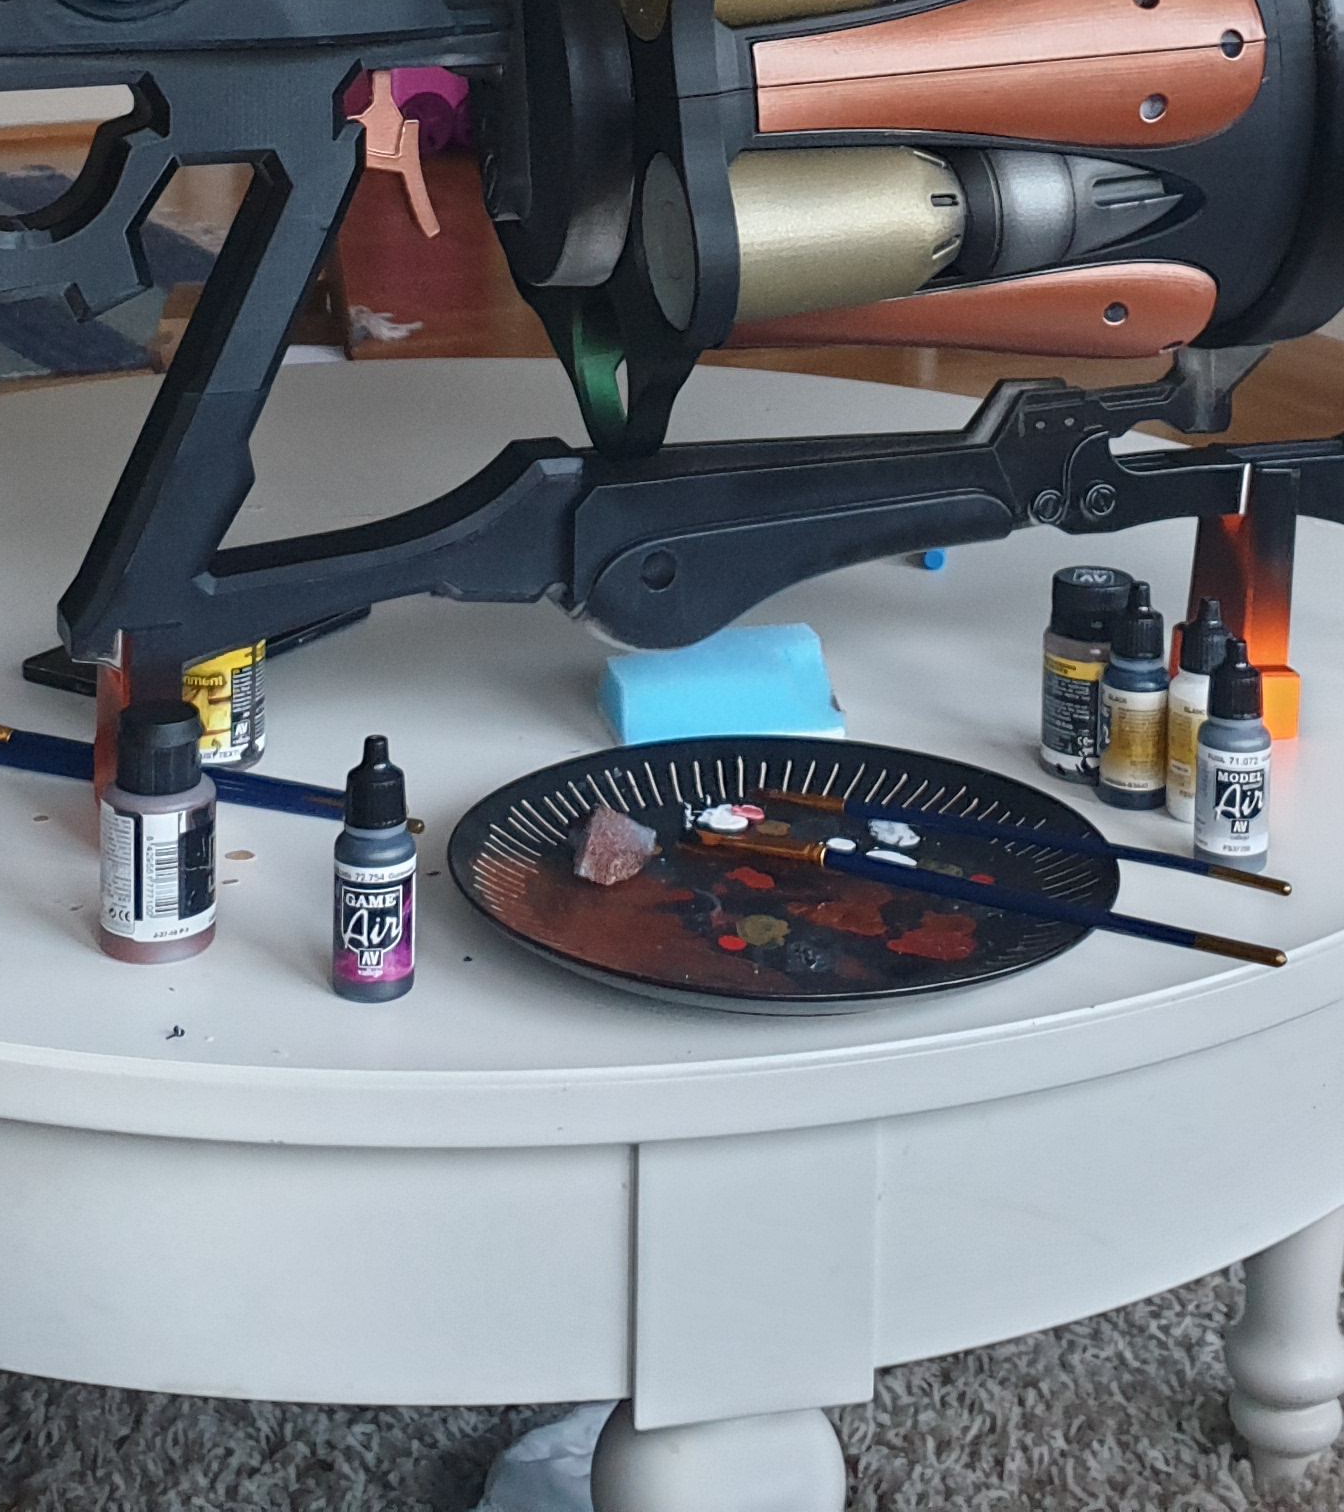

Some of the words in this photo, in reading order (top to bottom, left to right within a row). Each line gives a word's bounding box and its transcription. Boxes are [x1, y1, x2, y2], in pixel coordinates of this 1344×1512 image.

[1217, 771, 1263, 783] MODEL
[1214, 783, 1264, 820] Air
[1233, 820, 1248, 833] AV
[345, 892, 397, 908] GAME
[343, 908, 401, 948] Air
[361, 950, 380, 966] AV
